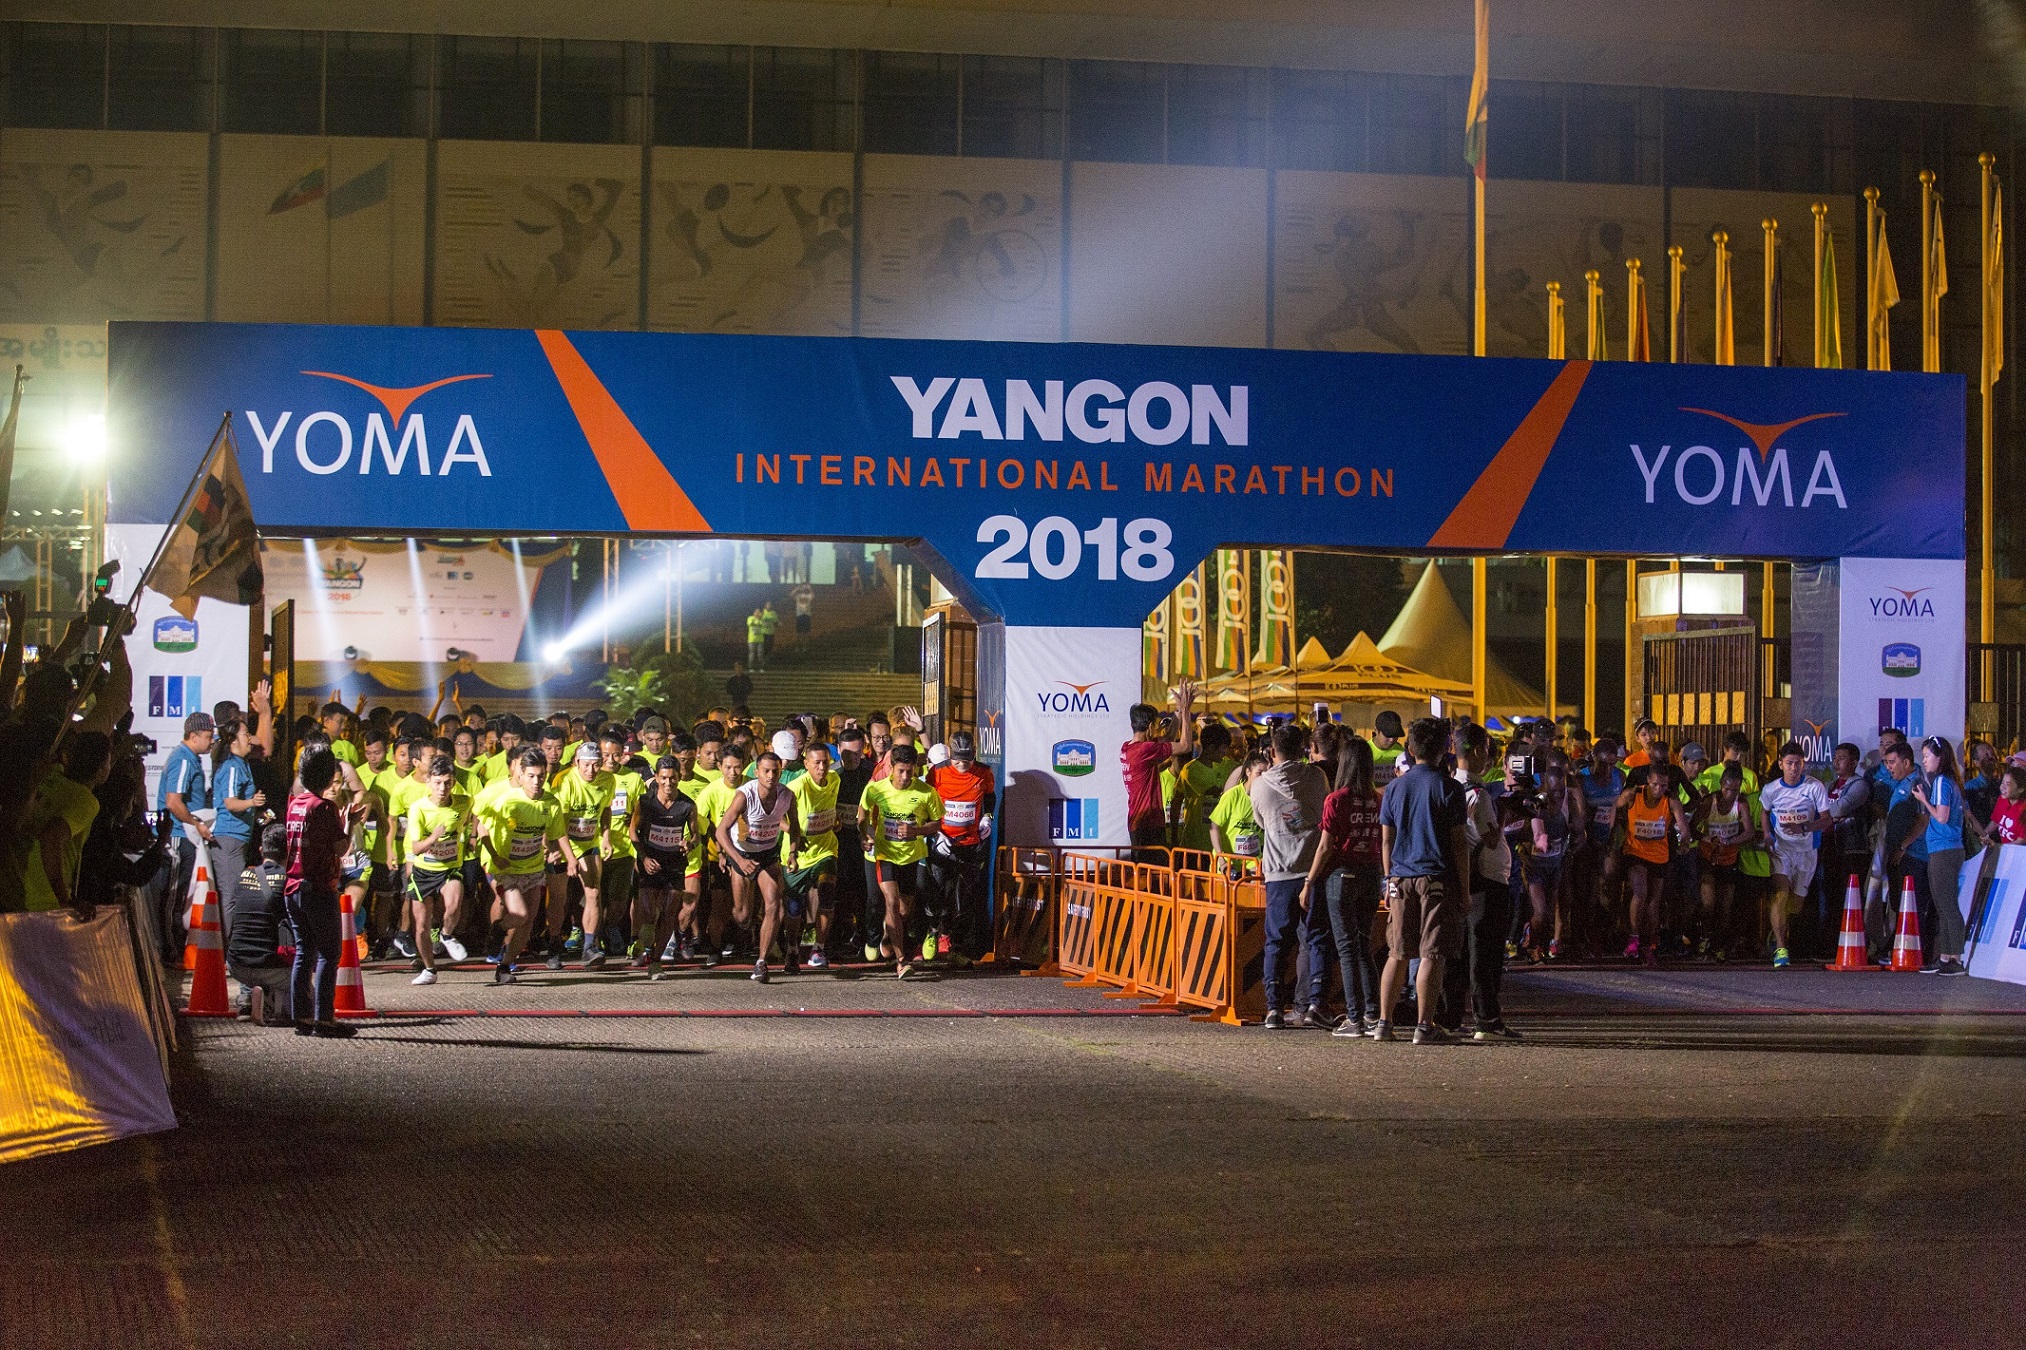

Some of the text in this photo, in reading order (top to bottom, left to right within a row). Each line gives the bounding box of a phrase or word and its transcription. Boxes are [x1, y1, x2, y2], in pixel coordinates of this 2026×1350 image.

[890, 376, 1249, 446] YANGON
[245, 411, 492, 476] YOMA
[736, 453, 1394, 497] INTERNATIONAL MARATHON
[1629, 444, 1848, 508] YOMA
[975, 515, 1175, 582] 2018
[1869, 598, 1935, 617] YOMA
[1037, 693, 1110, 712] YOMA
[979, 727, 1001, 755] YOMA
[946, 810, 974, 818] M4066
[1350, 813, 1380, 824] CREW
[651, 832, 680, 844] M4115
[1053, 827, 1094, 837] FMI
